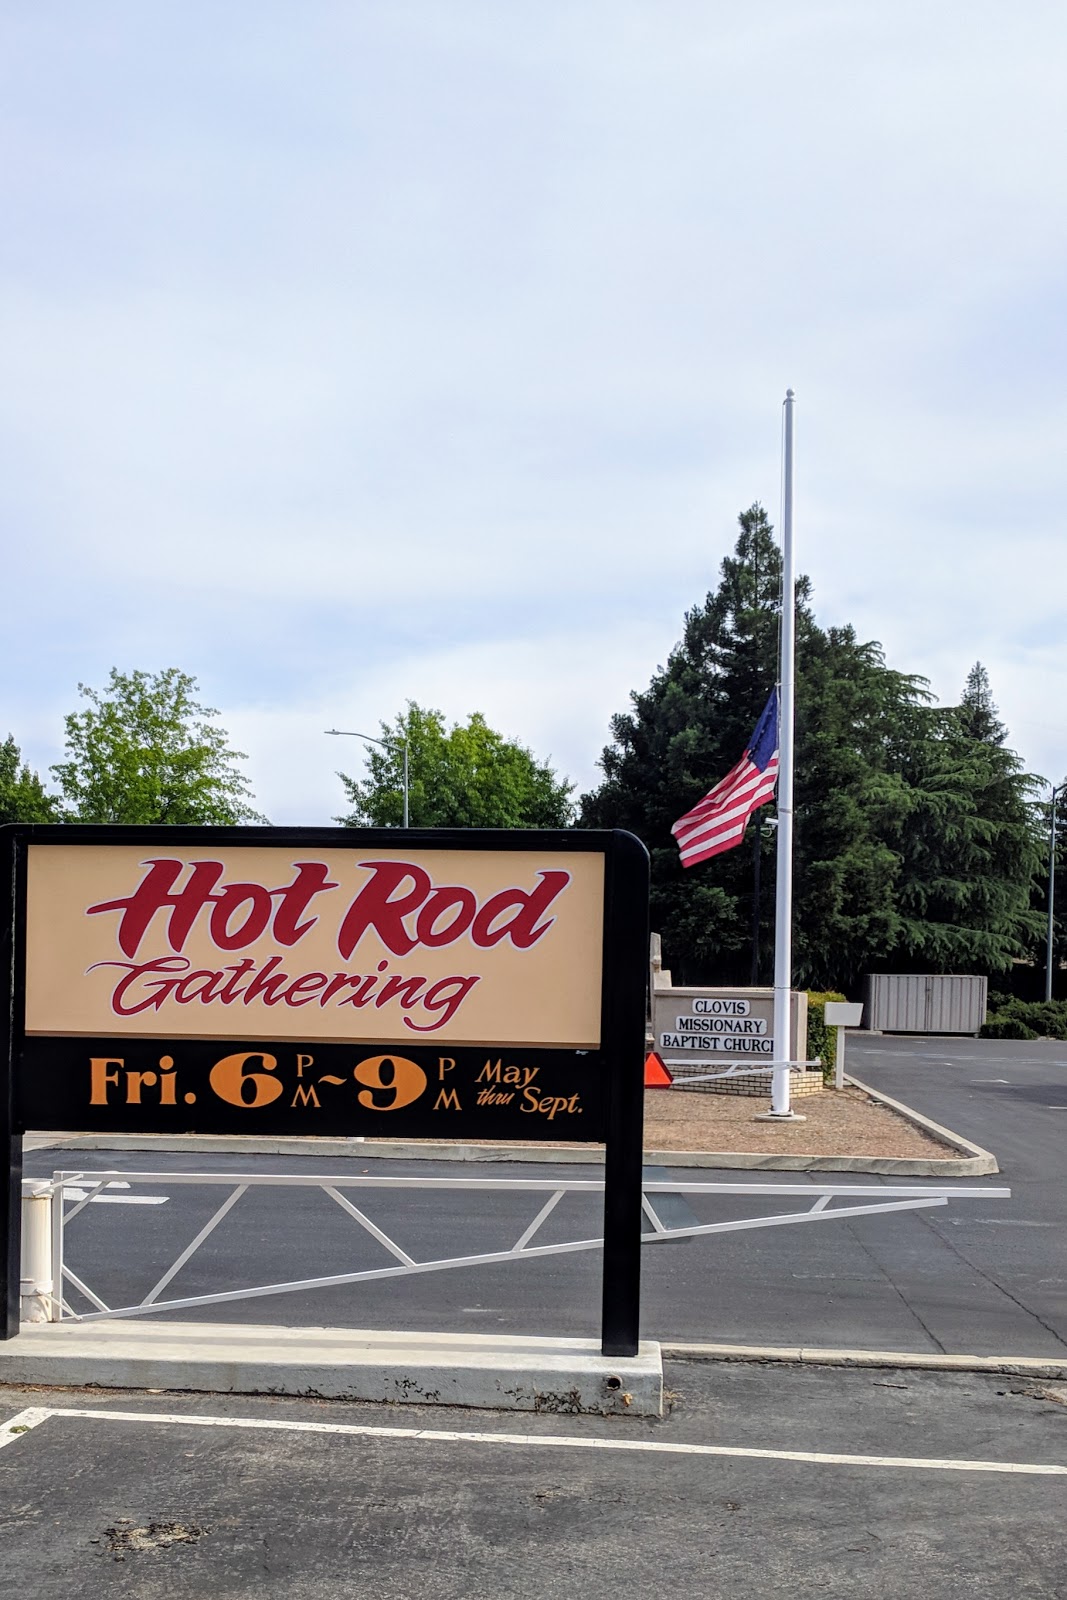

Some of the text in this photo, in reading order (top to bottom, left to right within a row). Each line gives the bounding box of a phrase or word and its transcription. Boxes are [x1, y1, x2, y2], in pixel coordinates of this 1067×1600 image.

[85, 858, 571, 962] Hot Rod
[84, 956, 482, 1032] Gathering
[694, 1000, 746, 1015] CLOVIS
[662, 1034, 720, 1050] BAPTIST
[678, 1018, 763, 1034] MISSIONARY
[89, 1055, 197, 1105] Fri.
[209, 1052, 284, 1108] 6
[353, 1054, 428, 1112] 9
[474, 1058, 541, 1090] May
[476, 1084, 584, 1121] thru Sept.
